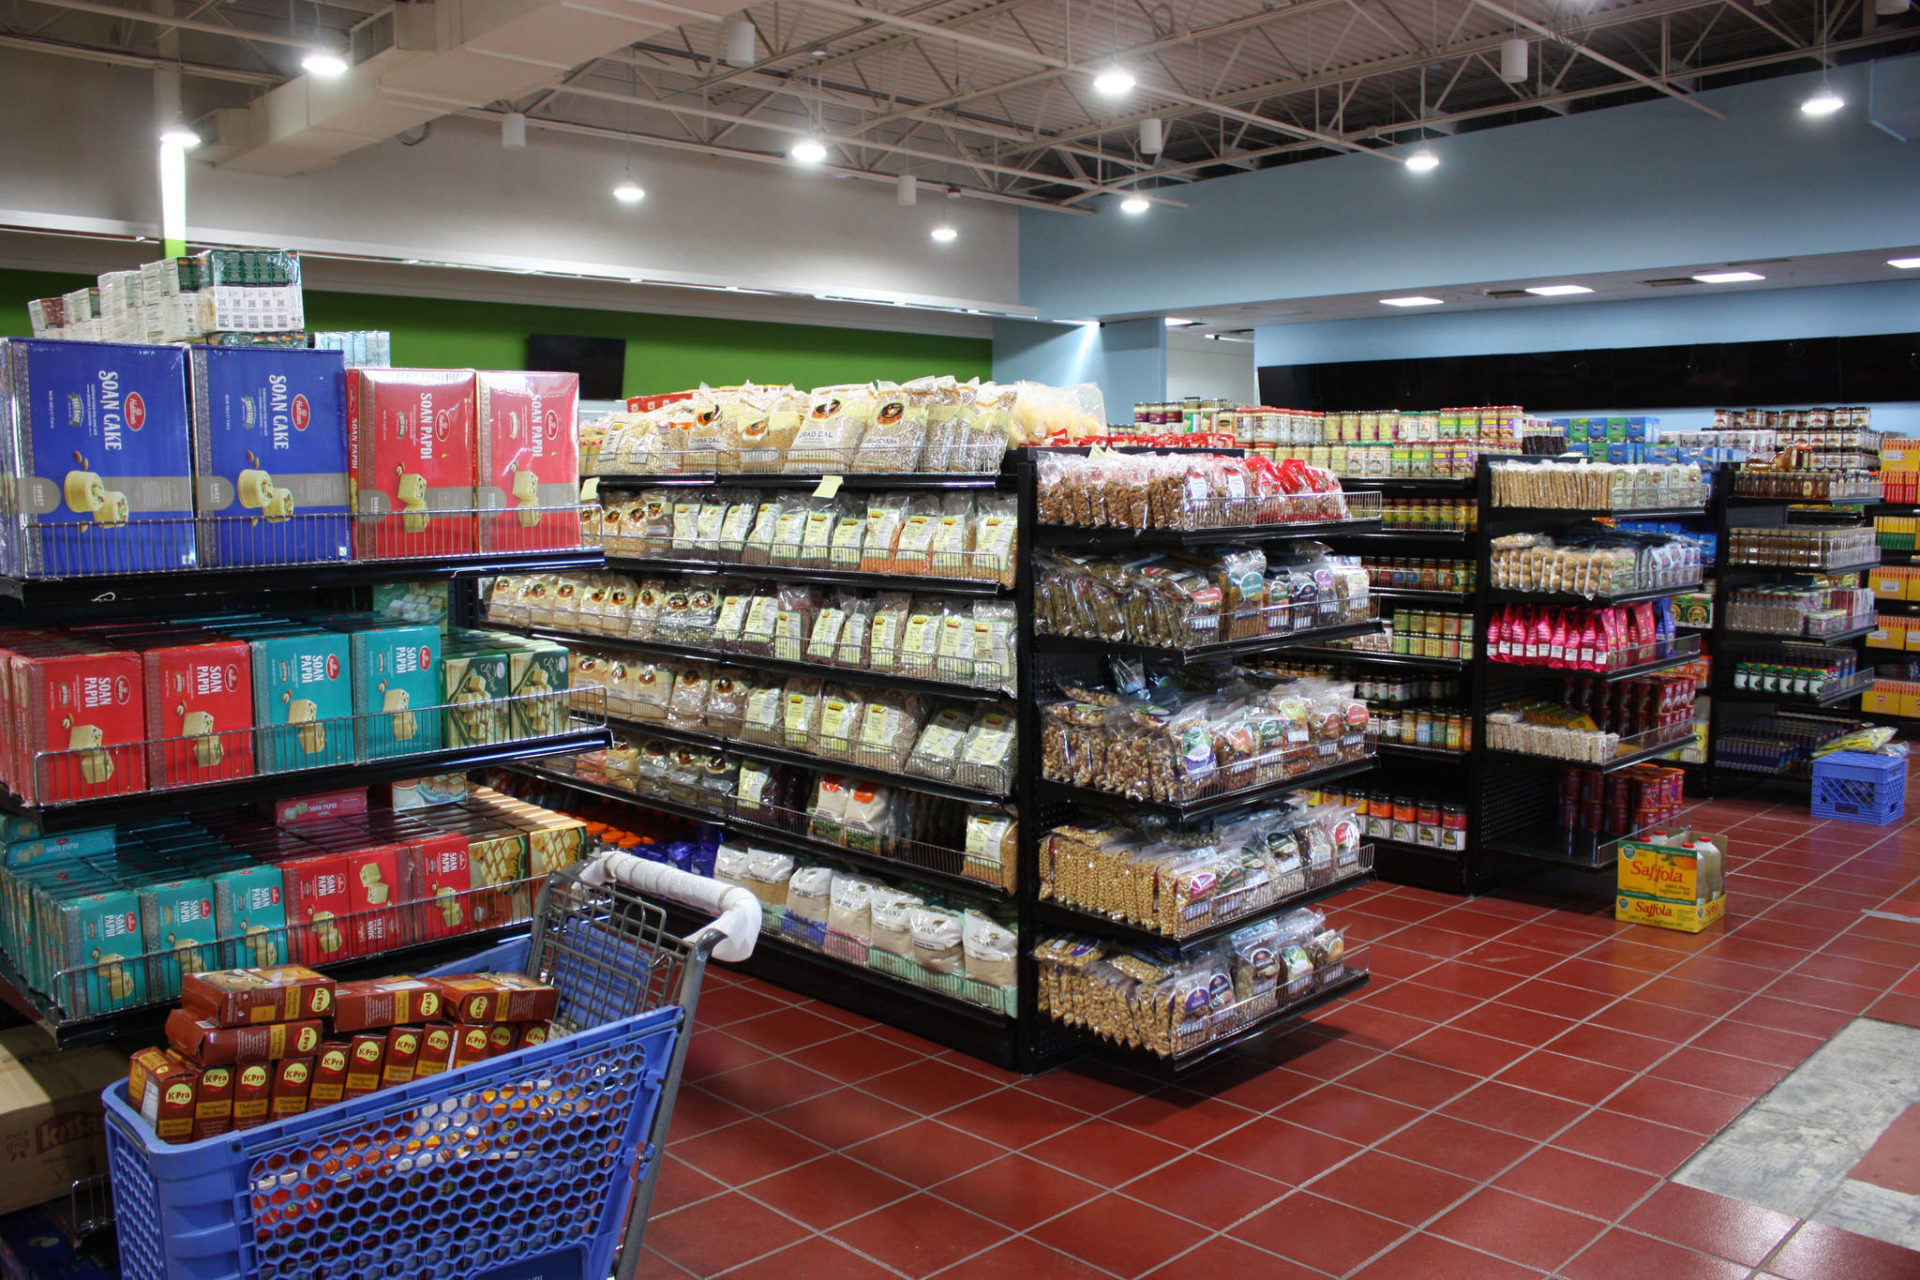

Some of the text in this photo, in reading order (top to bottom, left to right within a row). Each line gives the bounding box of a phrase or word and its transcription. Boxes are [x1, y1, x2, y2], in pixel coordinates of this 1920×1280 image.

[98, 370, 122, 451] SOAN CAKE
[268, 374, 289, 450] SOAN CAKE
[420, 392, 432, 460] SOAN PAPDI
[532, 394, 543, 458] SOAN PAPDI
[300, 655, 312, 684] PAPDI
[312, 656, 324, 682] SOAN
[396, 646, 406, 674] PAPDI
[406, 647, 417, 672] SOAN
[84, 677, 98, 708] PAPDI
[98, 678, 112, 706] SOAN
[197, 666, 210, 695] PAPDI
[210, 666, 223, 694] SOAN
[1630, 860, 1684, 882] Saffola
[318, 875, 326, 896] PAPDI
[326, 874, 336, 894] SOAN
[190, 900, 200, 920] SOAN
[252, 888, 261, 910] PAPDI
[261, 888, 270, 908] SOAN
[1635, 901, 1672, 918] Saffola
[181, 900, 190, 923] PAPDI
[104, 914, 114, 938] PAPDI
[114, 914, 124, 936] SOAN
